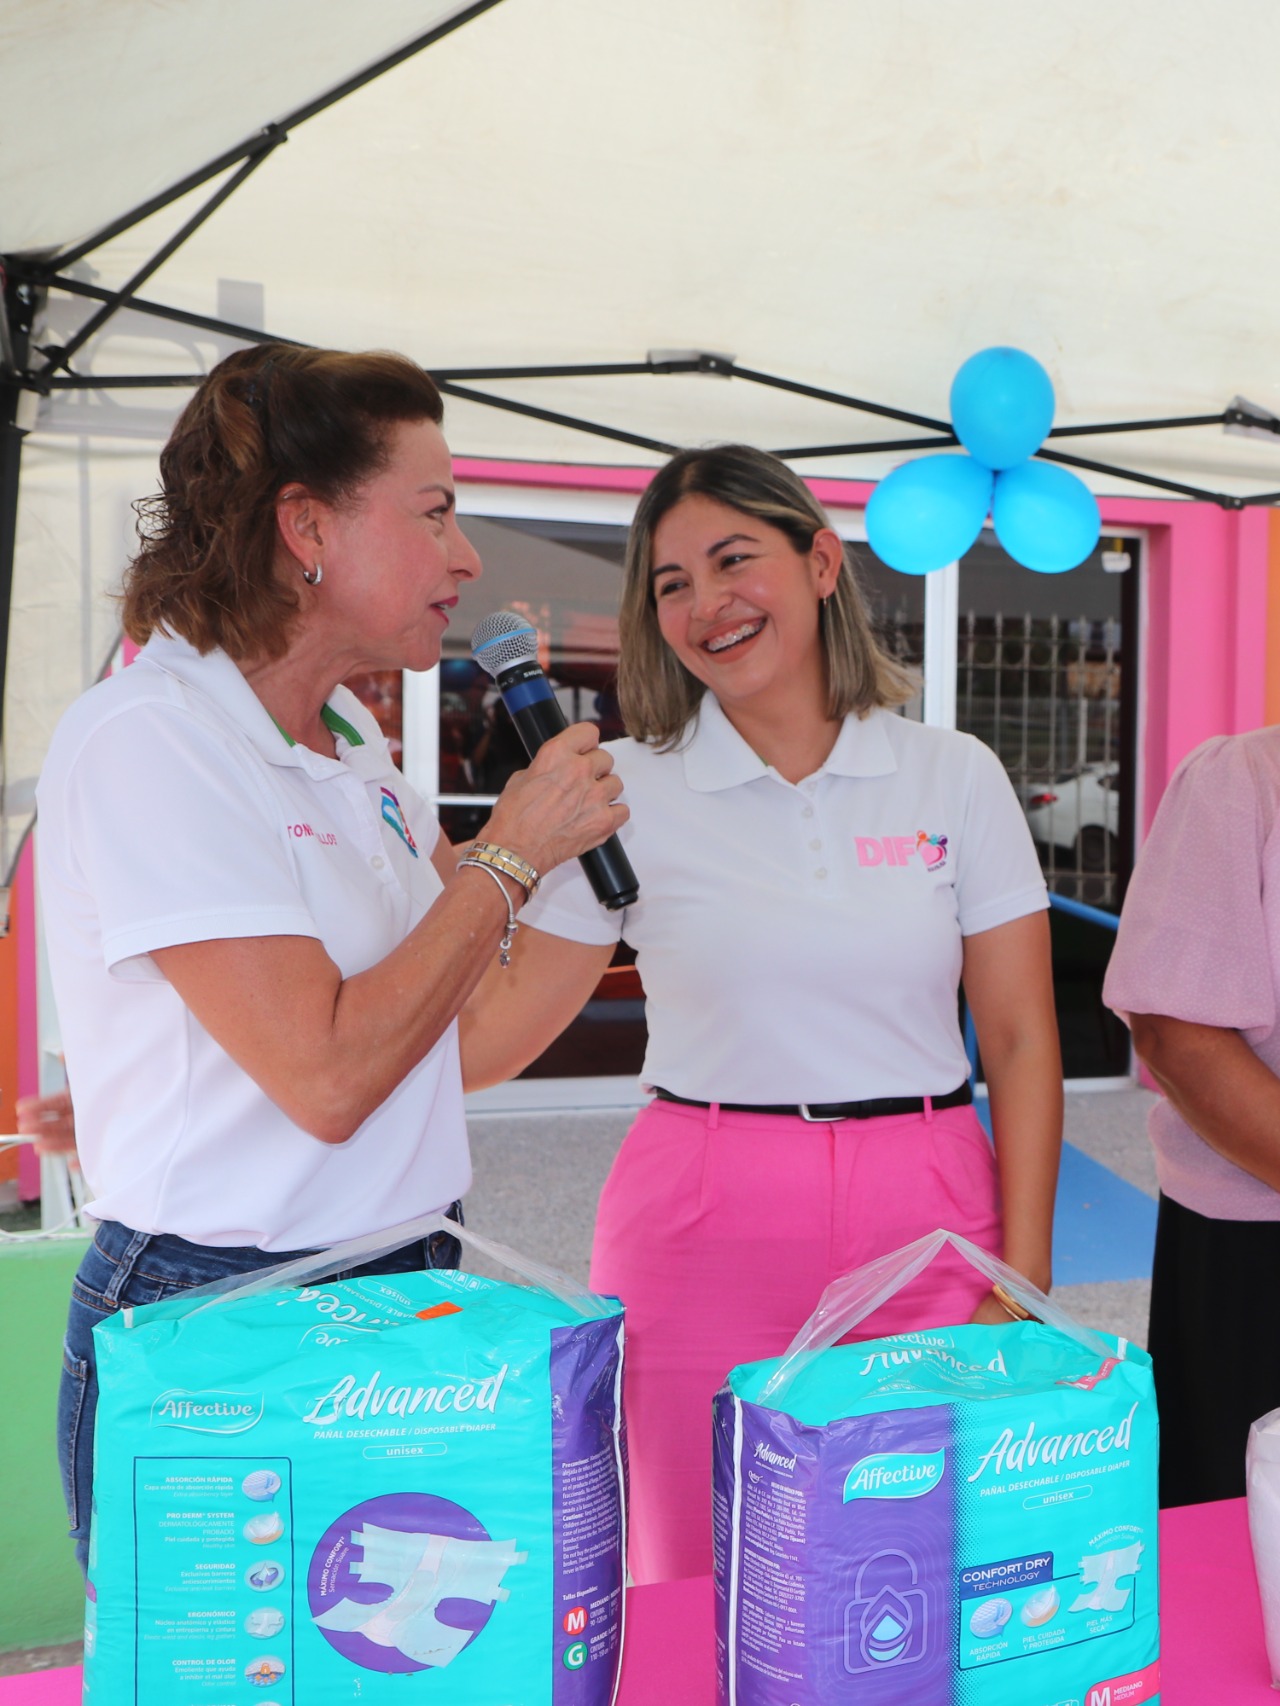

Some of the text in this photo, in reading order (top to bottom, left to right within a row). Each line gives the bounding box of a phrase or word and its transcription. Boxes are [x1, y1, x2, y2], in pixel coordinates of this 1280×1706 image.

[854, 836, 916, 867] DIF
[380, 1286, 411, 1306] unisex
[302, 1363, 508, 1425] Advanced
[158, 1399, 255, 1419] Affective
[313, 1428, 344, 1439] PAÑAL
[346, 1428, 407, 1438] DESECHABLE
[414, 1424, 465, 1435] DISPOSABLE
[466, 1423, 497, 1432] DIAPER
[386, 1445, 424, 1456] unisex
[967, 1401, 1139, 1483] Advanced
[753, 1442, 798, 1472] Advanced
[851, 1464, 938, 1491] Affective
[980, 1484, 1006, 1497] PAÑAL
[1007, 1475, 1060, 1493] DESECHABLE
[1065, 1465, 1106, 1481] DISPOSABLE
[1107, 1460, 1131, 1473] DIAPER
[1042, 1491, 1074, 1505] unisex
[159, 1519, 234, 1527] DERMATOLÓGICAMENTE
[962, 1557, 1051, 1583] CONFORT DRY
[319, 1569, 329, 1596] MÁXIMO
[973, 1571, 1041, 1592] TECHNOLOGY
[567, 1610, 585, 1632] M
[1086, 1615, 1113, 1628] PIEL MÁS
[1022, 1628, 1066, 1644] PIEL CUIDADA
[1028, 1635, 1065, 1649] PROTEGIDA
[568, 1644, 583, 1666] G
[969, 1641, 1009, 1656] ABSORCIÓN
[976, 1650, 1001, 1662] RÁPIDA
[1091, 1681, 1143, 1706] M MEDIANO
